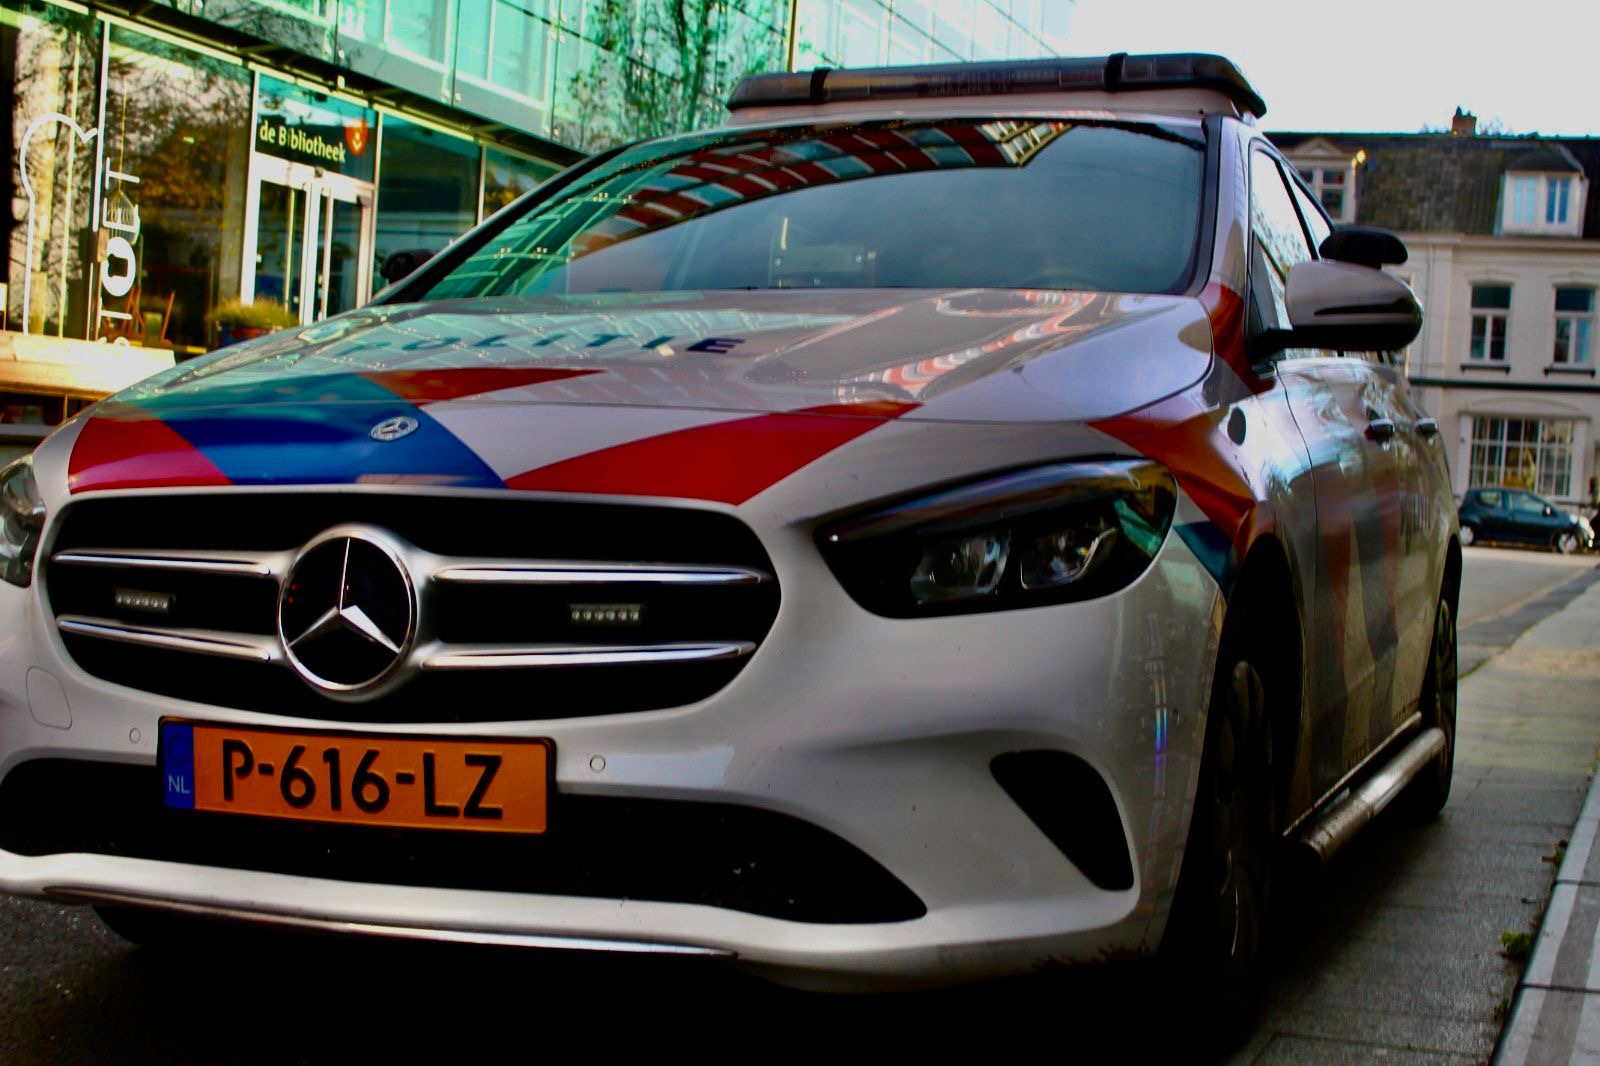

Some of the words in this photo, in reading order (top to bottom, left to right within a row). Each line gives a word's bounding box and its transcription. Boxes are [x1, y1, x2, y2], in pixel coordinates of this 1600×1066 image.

[259, 119, 276, 143] de
[278, 125, 346, 163] Bibliotheek
[334, 333, 745, 356] POLITIE
[168, 774, 190, 794] NL
[222, 738, 504, 820] P-616-LZ
